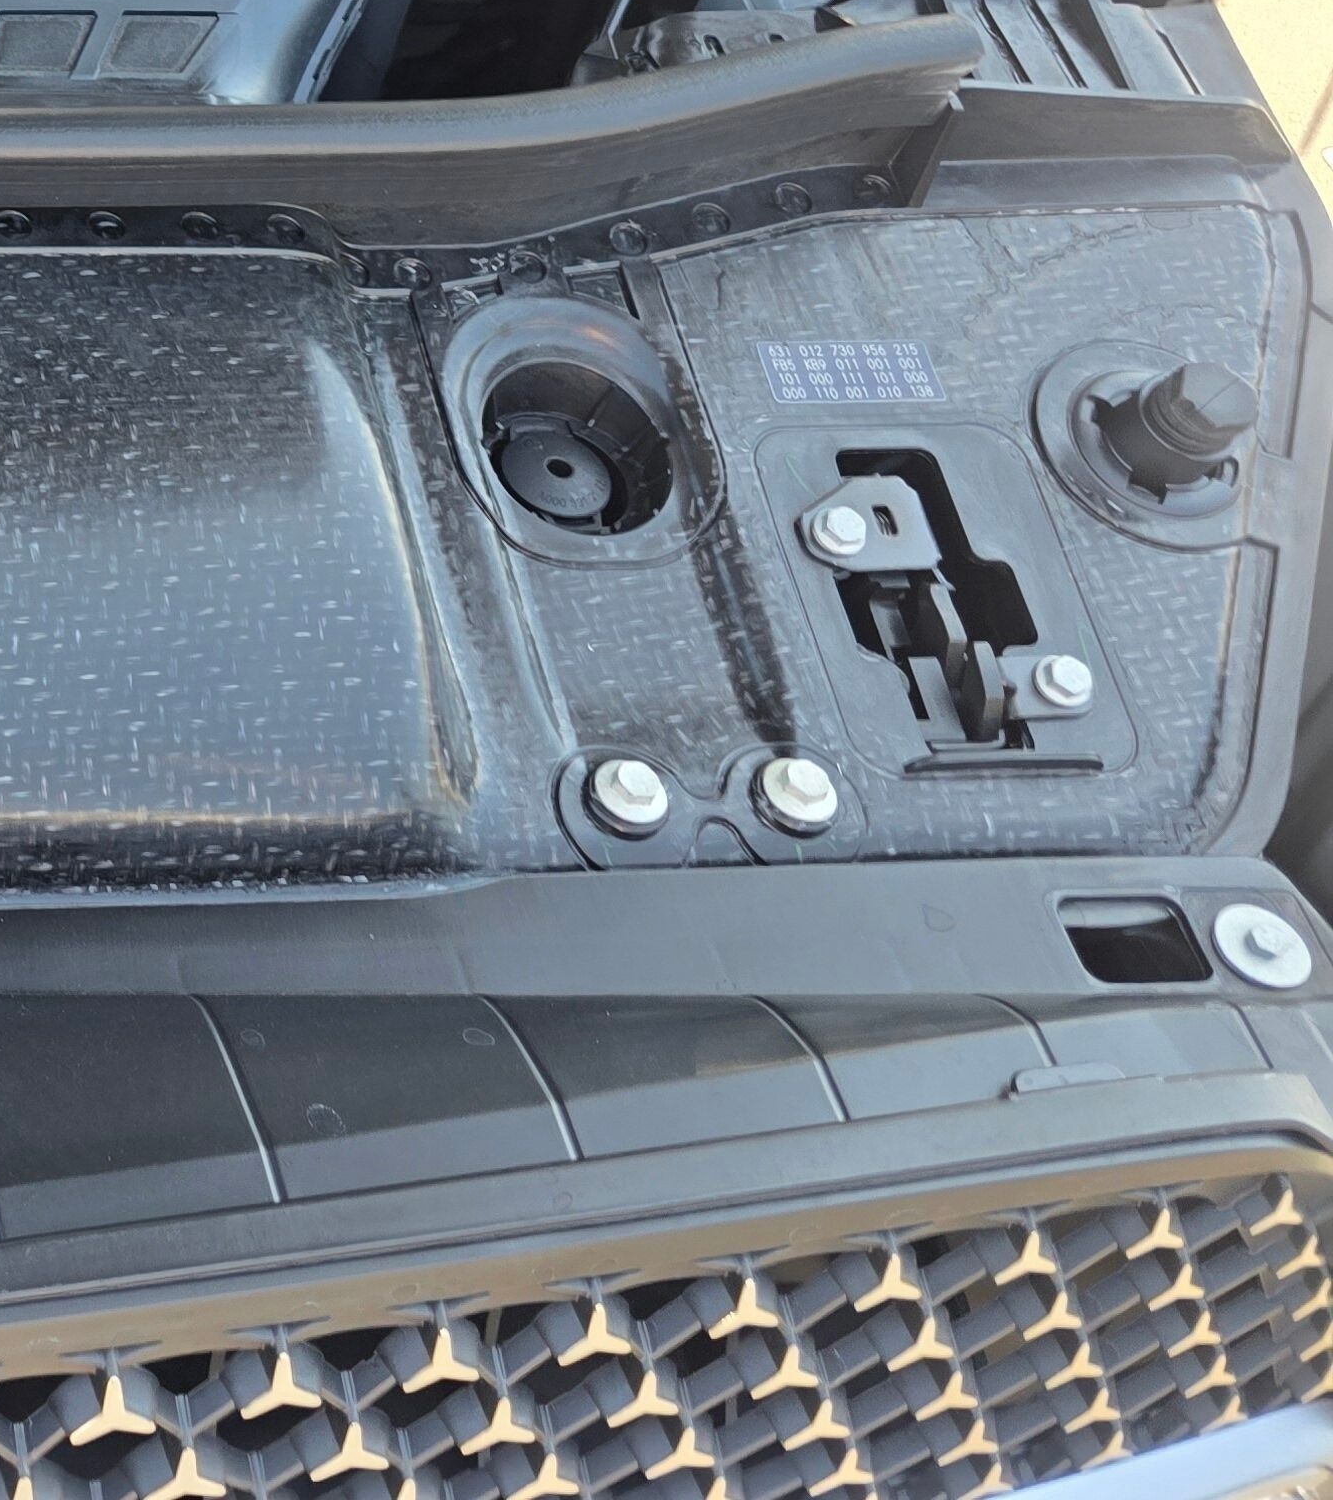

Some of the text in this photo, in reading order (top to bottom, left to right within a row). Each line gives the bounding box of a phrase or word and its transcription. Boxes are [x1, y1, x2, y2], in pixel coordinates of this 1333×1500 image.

[768, 343, 918, 357] 631 012 730 956 215
[835, 357, 860, 371] 011
[866, 357, 891, 371] 001
[897, 357, 923, 370] 001
[778, 370, 929, 385] 101 000 111 101 000
[782, 384, 934, 400] 000 110 001 010 138
